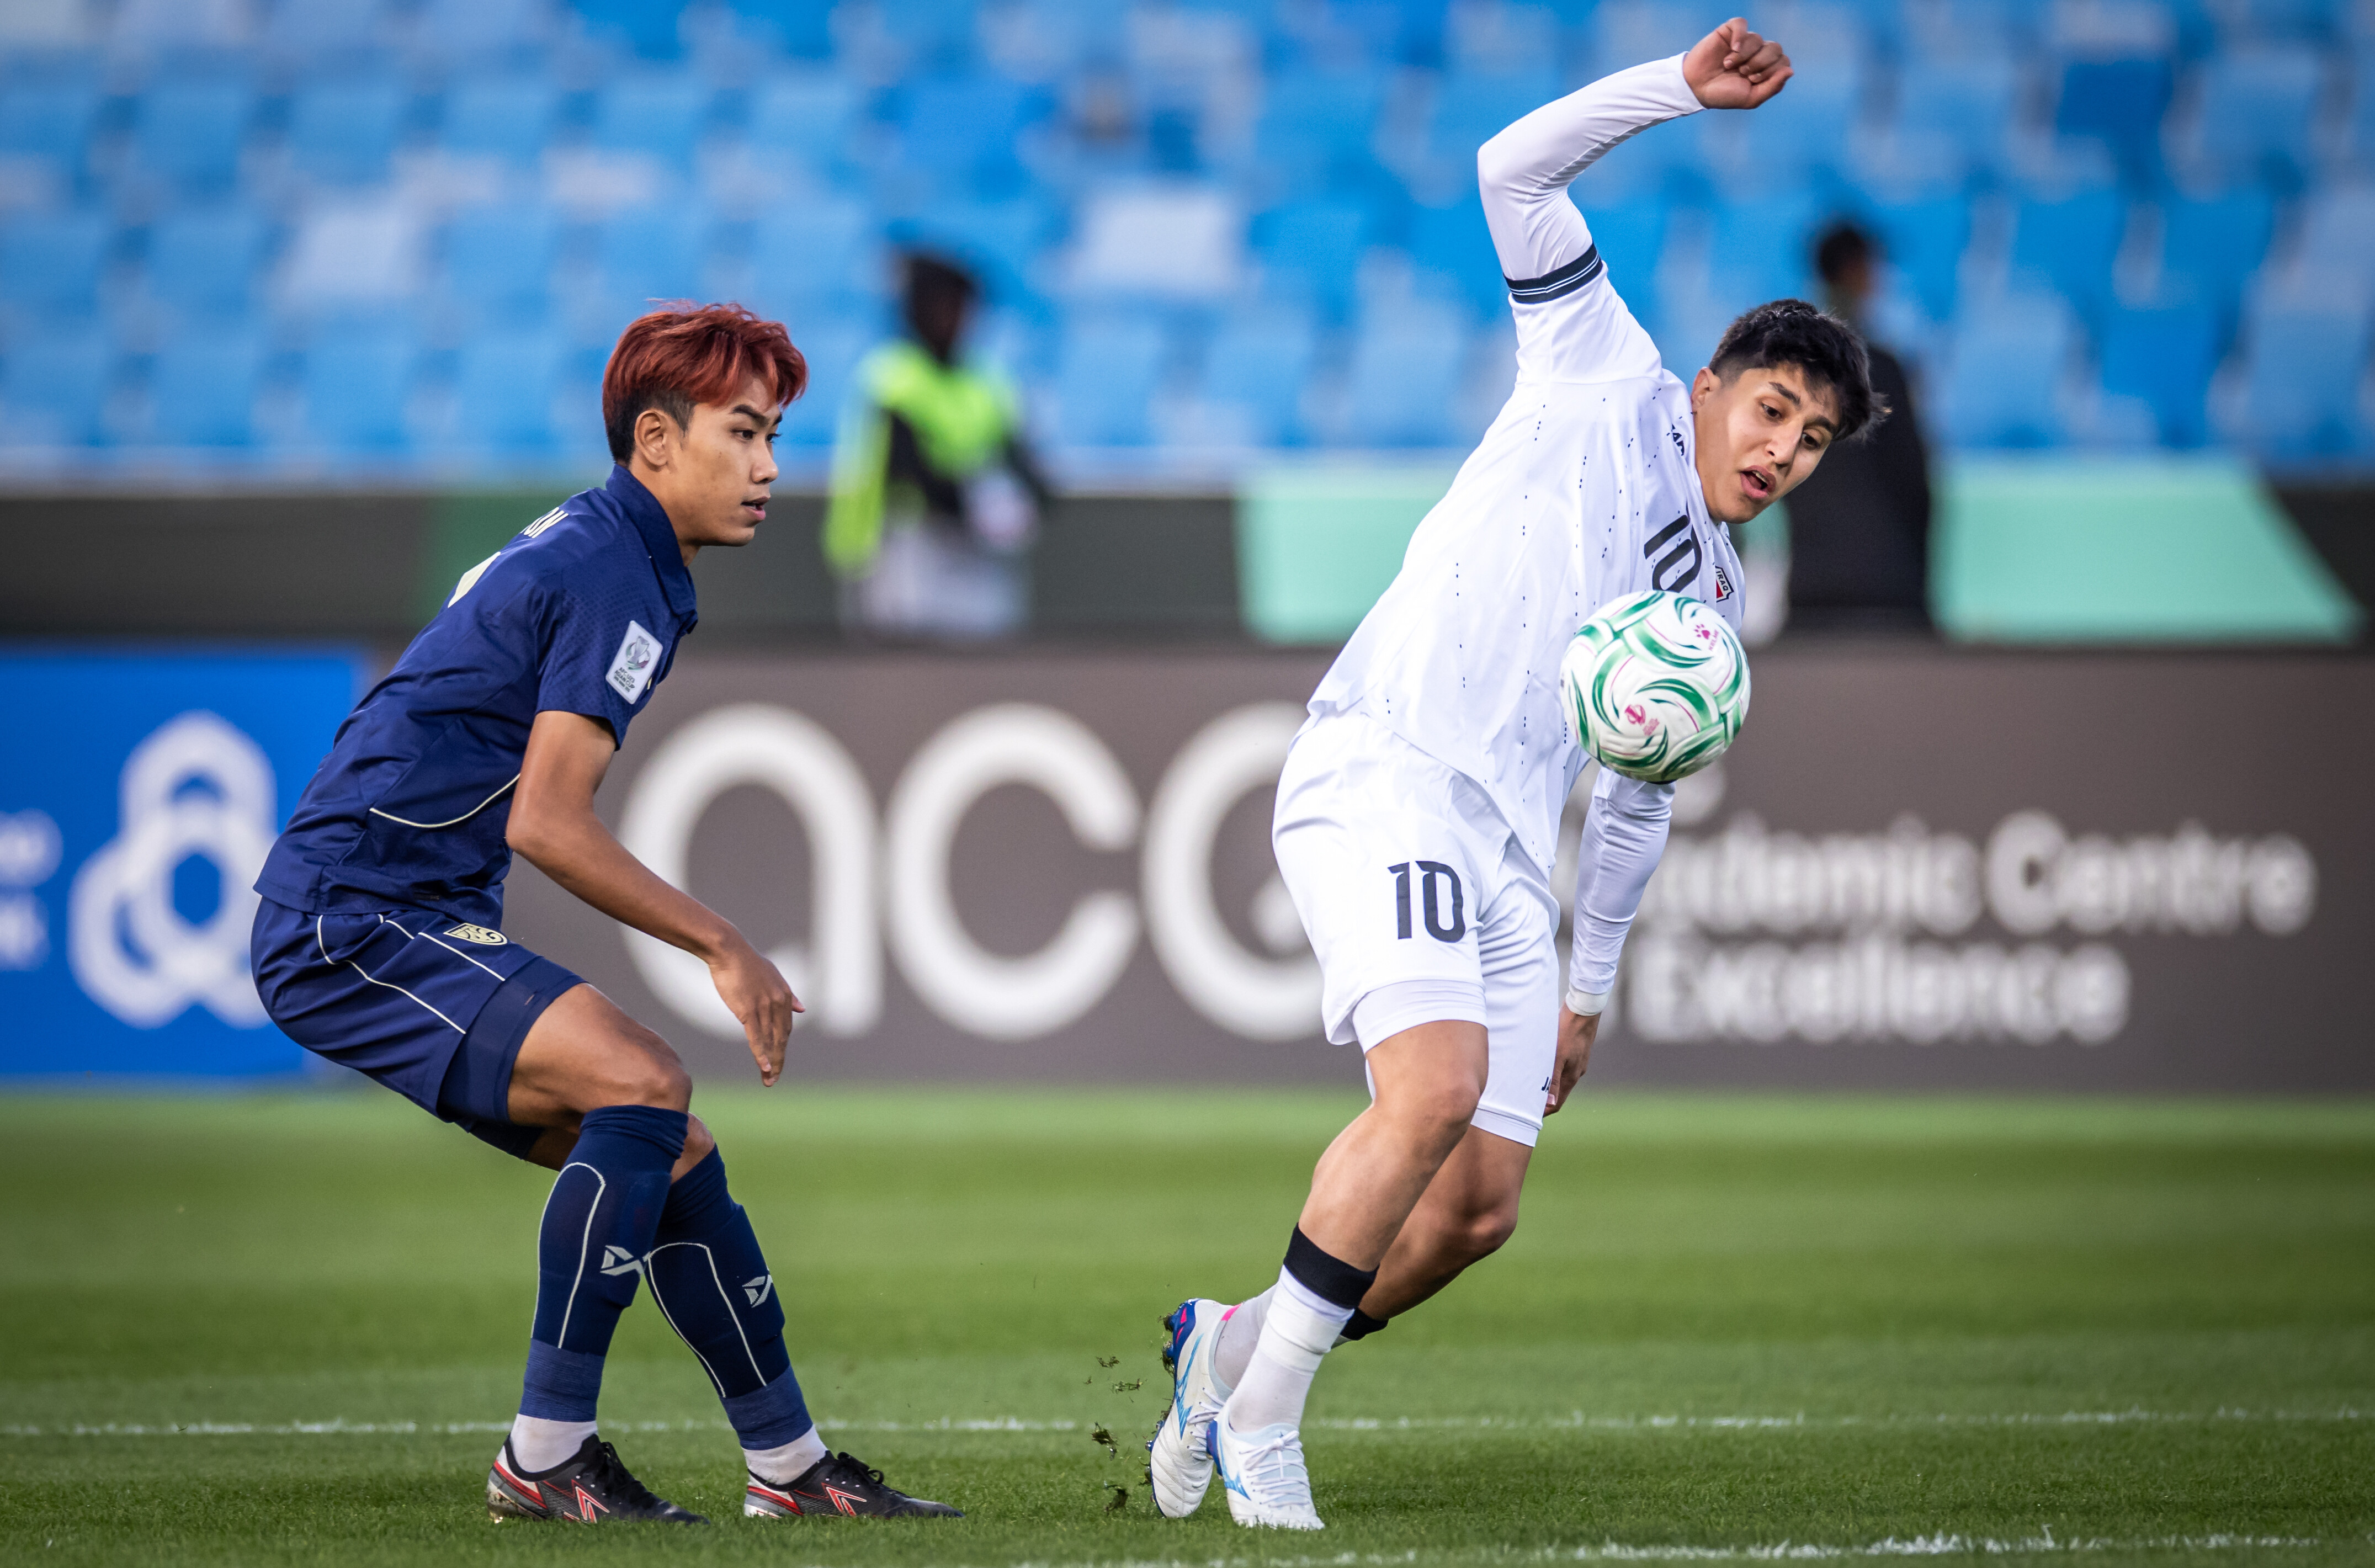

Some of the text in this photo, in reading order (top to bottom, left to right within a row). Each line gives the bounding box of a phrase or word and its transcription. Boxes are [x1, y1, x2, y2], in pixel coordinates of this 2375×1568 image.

[1644, 501, 1702, 592] 10
[1715, 571, 1729, 591] IRAQ
[1387, 860, 1466, 943] 10
[1987, 810, 2317, 935] Centre
[1625, 929, 2129, 1042] Excellence
